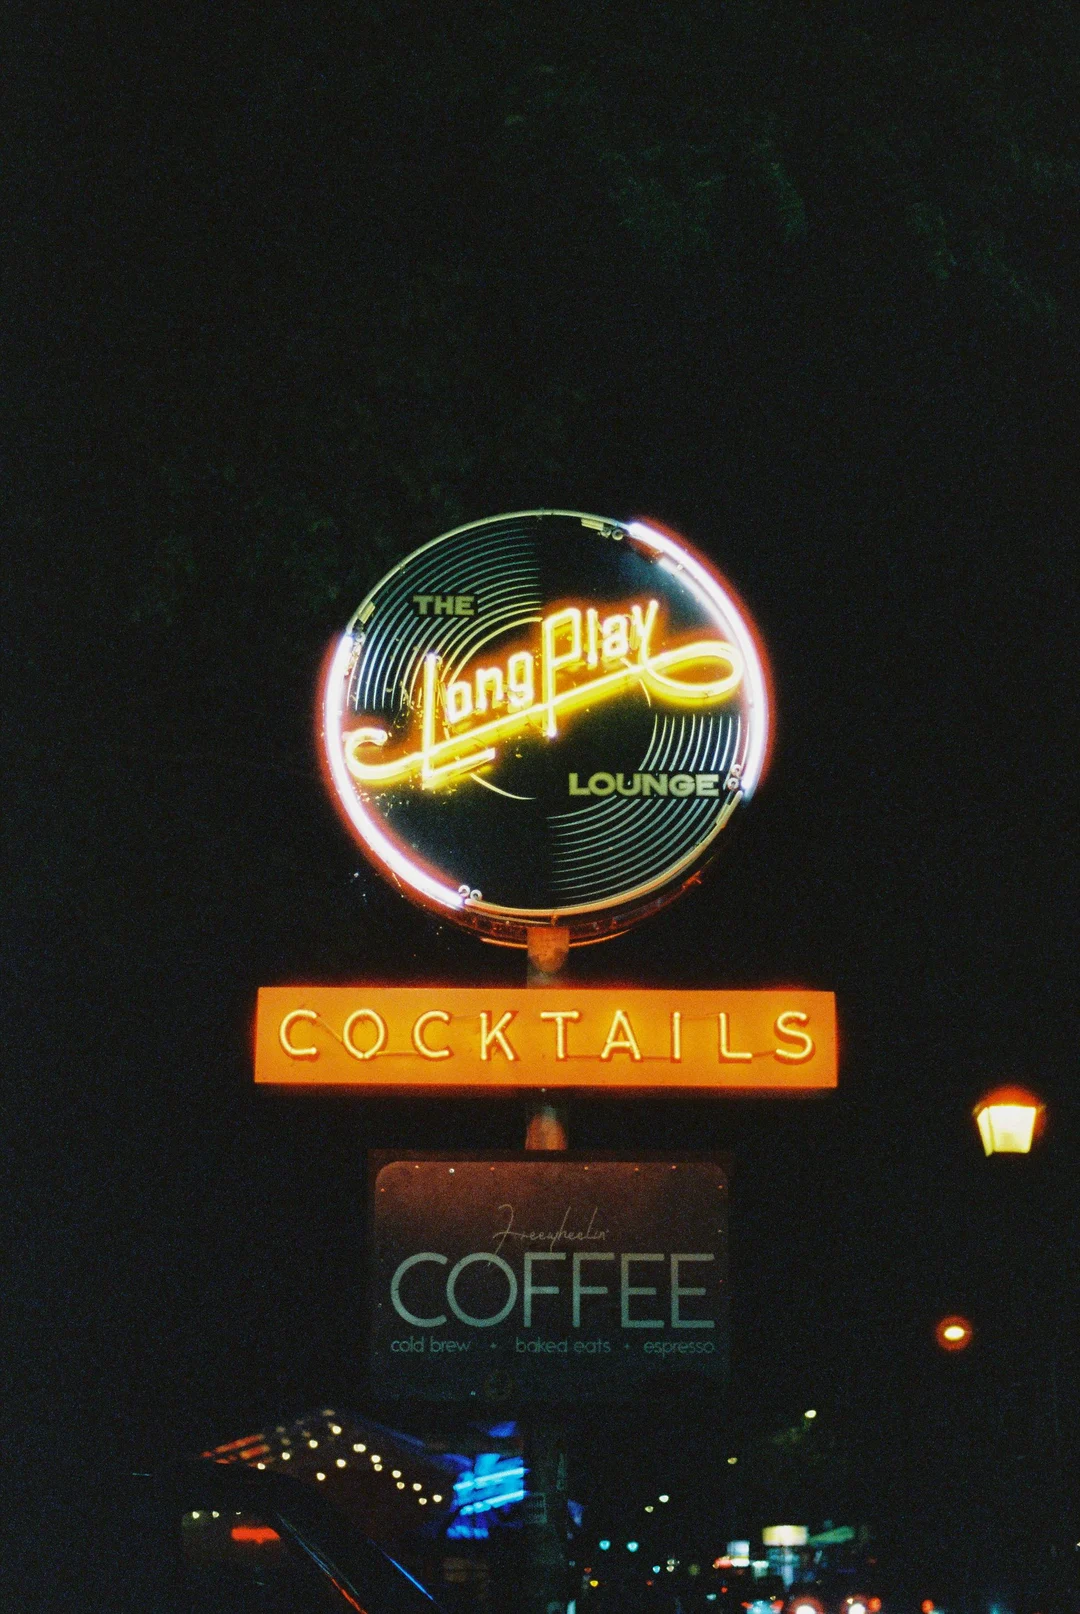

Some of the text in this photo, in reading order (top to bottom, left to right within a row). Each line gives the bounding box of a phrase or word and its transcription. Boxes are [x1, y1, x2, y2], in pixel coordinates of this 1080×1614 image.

[412, 594, 475, 617] THE
[419, 600, 664, 790] Long Play
[568, 772, 720, 797] LOUNGE
[278, 1007, 815, 1062] COCKTAILS
[390, 1251, 716, 1329] COFFEE
[390, 1335, 716, 1359] cold brew baked eats espresso
